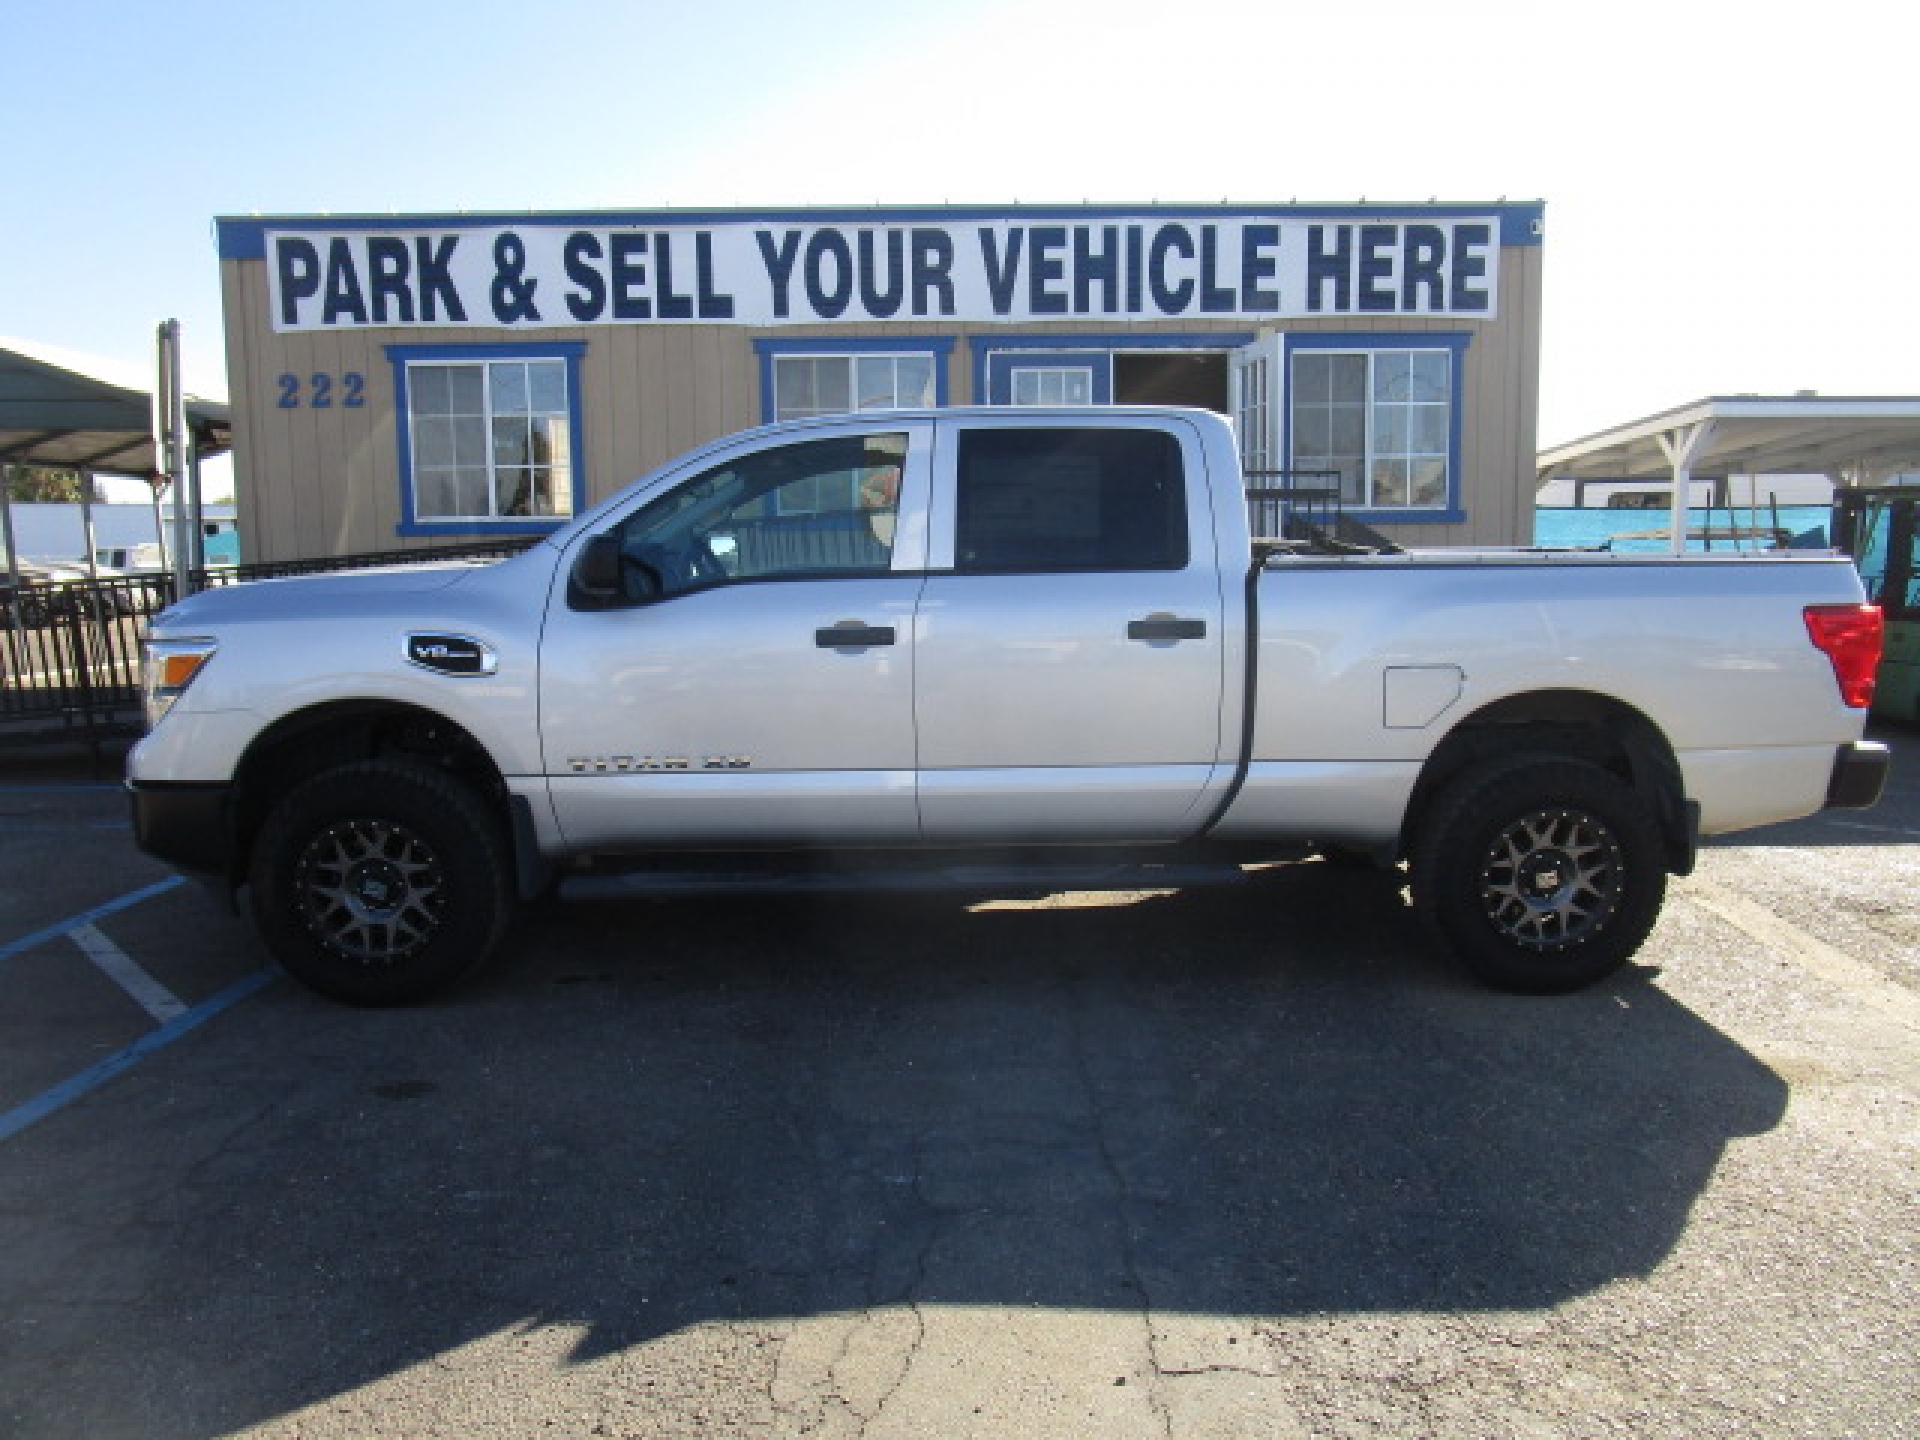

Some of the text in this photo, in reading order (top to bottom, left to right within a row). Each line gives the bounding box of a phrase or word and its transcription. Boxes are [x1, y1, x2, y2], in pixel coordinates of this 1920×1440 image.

[275, 223, 1490, 325] PARK & SELL YOUR VEHICLE HERE
[278, 372, 366, 408] 222
